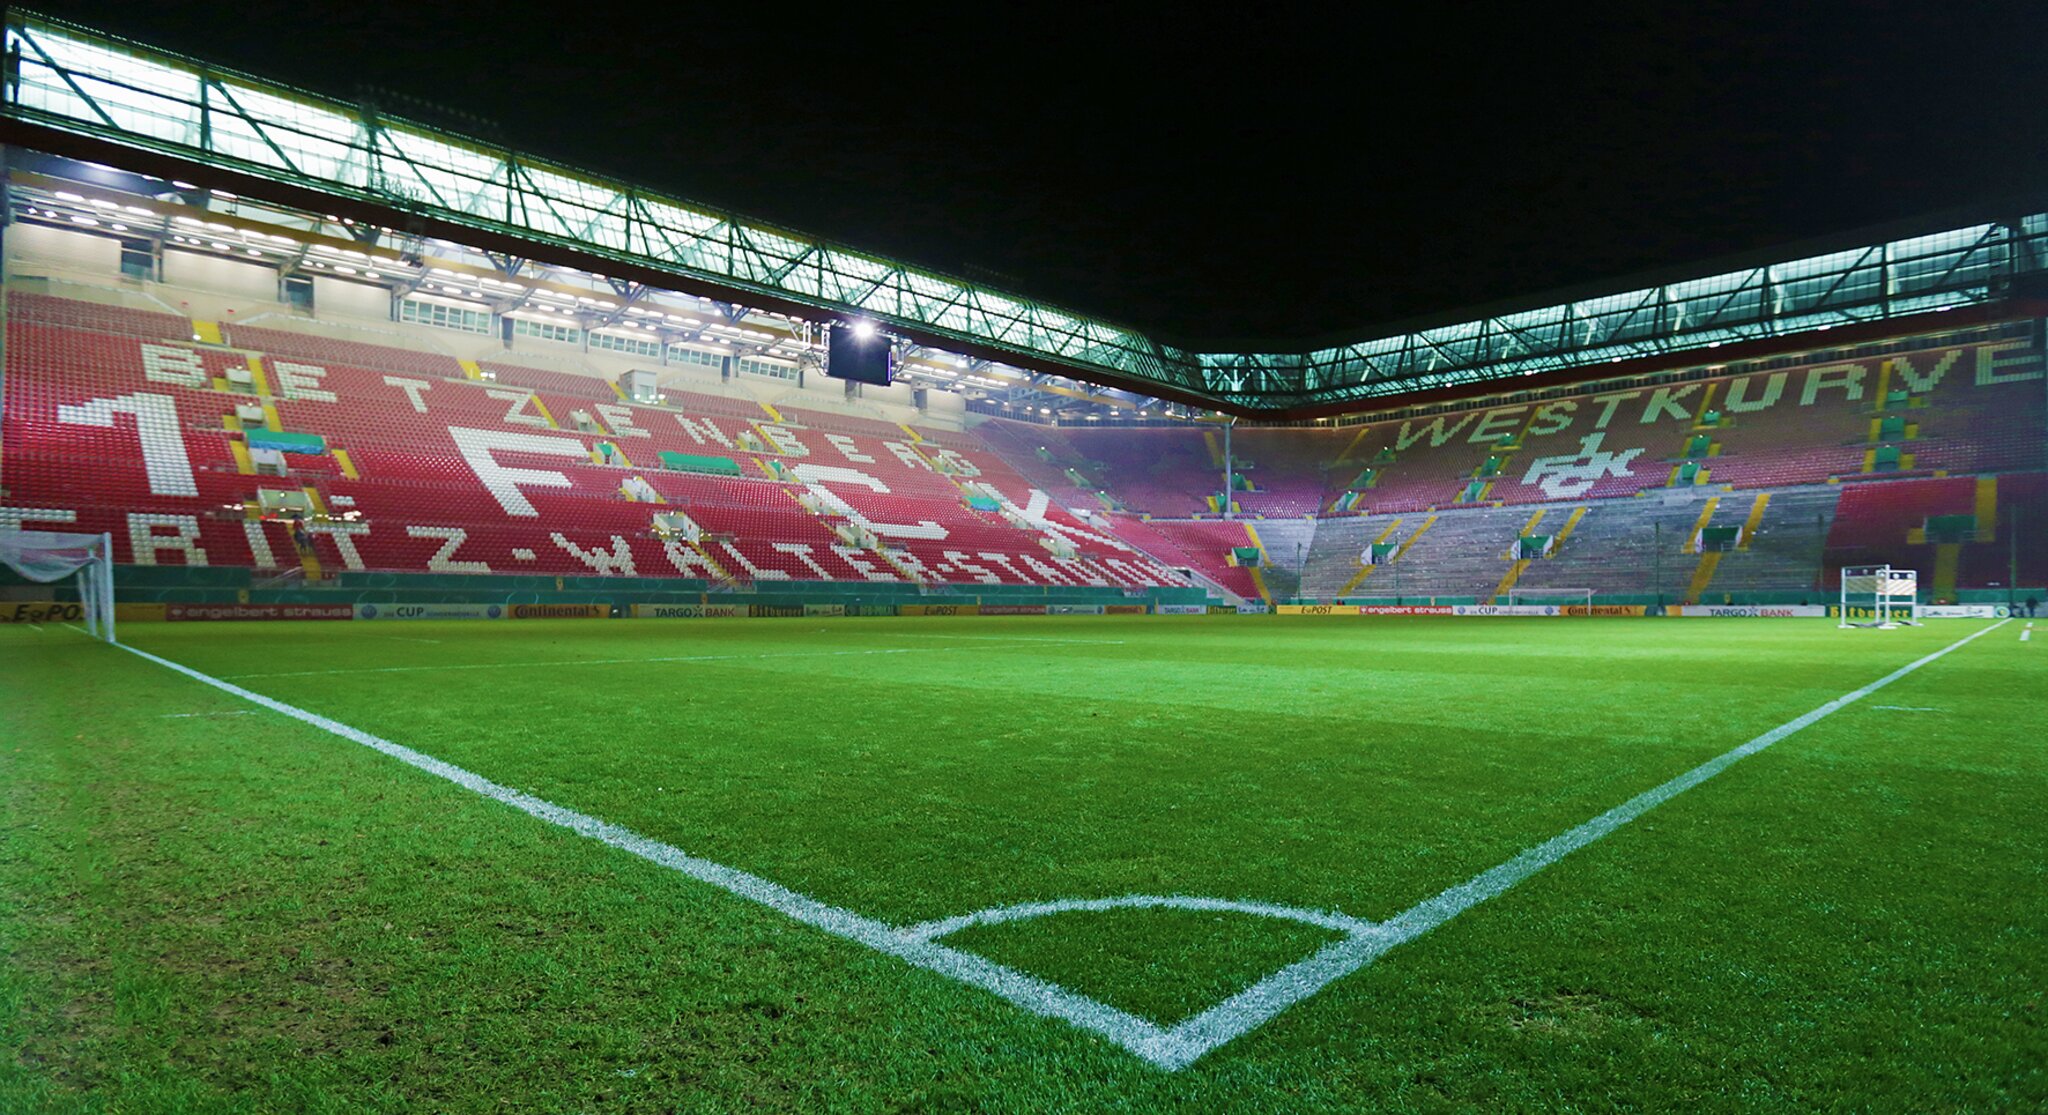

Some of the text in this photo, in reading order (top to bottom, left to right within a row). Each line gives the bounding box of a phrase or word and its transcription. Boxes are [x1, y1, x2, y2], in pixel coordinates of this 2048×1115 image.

[1396, 341, 2044, 450] WESTKURVE
[141, 343, 981, 477] BETZENBERG
[187, 607, 350, 619] engelbert strauss
[397, 607, 424, 617] CUP
[514, 604, 589, 618] Continental
[654, 607, 735, 618] TARGO BANK
[1368, 606, 1453, 615] engelbert strauss
[1568, 606, 1622, 616] Contnental
[1710, 608, 1793, 617] TARGO BANK
[1829, 605, 1909, 618] Btburer
